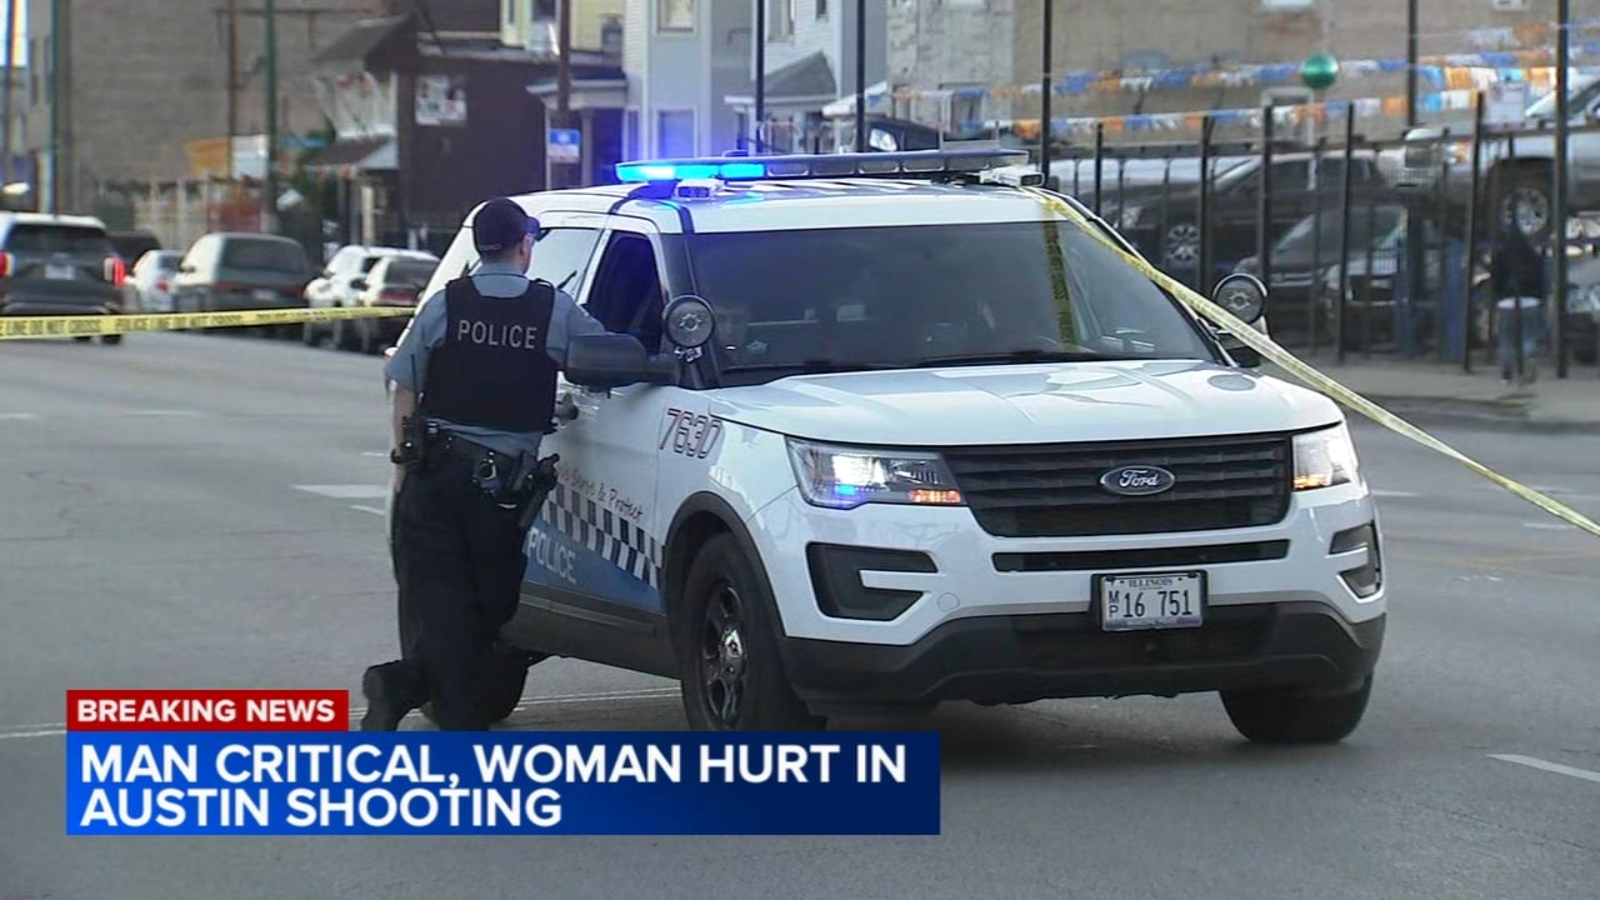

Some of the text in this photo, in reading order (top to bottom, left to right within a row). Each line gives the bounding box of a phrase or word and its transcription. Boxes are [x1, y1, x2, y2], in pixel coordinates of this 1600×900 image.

[6, 319, 29, 336] LINE
[114, 318, 148, 331] POLICE
[457, 319, 538, 349] POLICE
[1119, 469, 1160, 487] Ford
[526, 527, 577, 584] POLICE
[1129, 579, 1174, 588] ILLINOIS
[1123, 590, 1193, 618] 16 751
